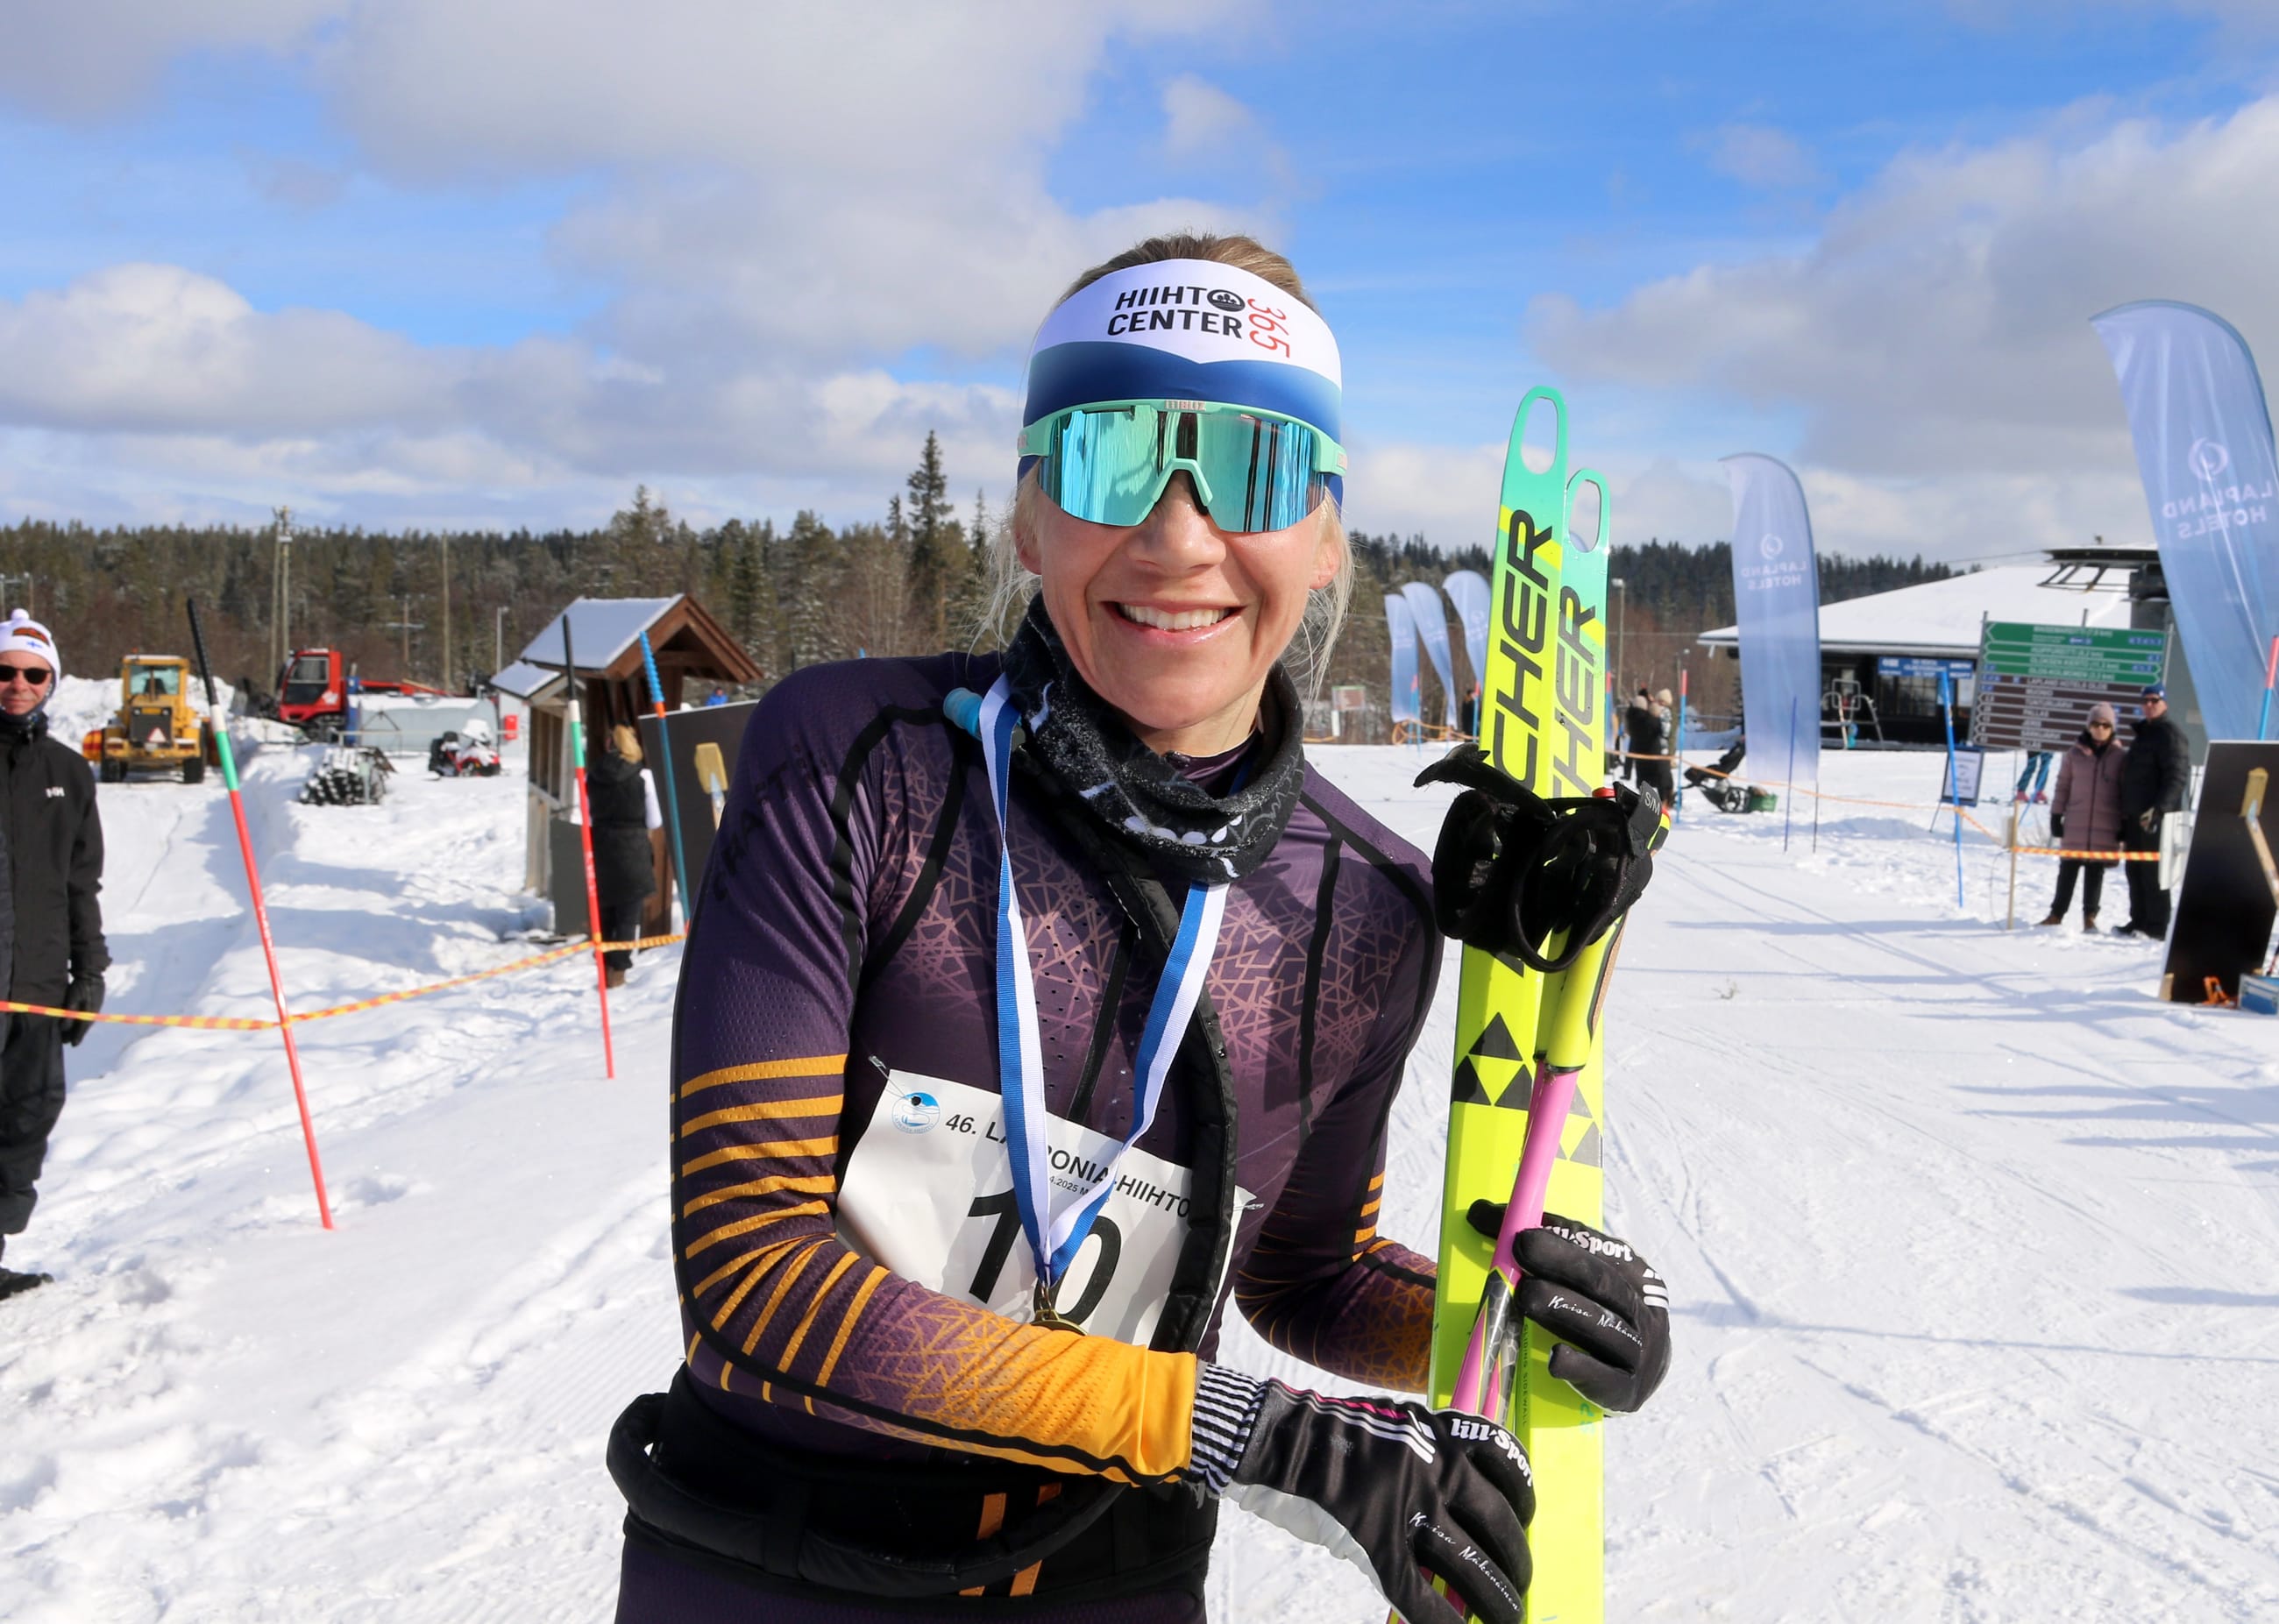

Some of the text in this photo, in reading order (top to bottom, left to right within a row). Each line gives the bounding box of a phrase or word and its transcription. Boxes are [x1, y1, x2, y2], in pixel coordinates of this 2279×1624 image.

[1114, 286, 1246, 312] HIIHTO
[1107, 309, 1242, 339] CENTER
[1247, 298, 1290, 358] 365
[1493, 508, 1553, 792] CHER
[1644, 791, 1660, 816] S/M
[945, 1113, 1191, 1218] 46. LONIAHIIHTO
[967, 1187, 1122, 1327] 10
[1547, 1294, 1593, 1317] Kaisa
